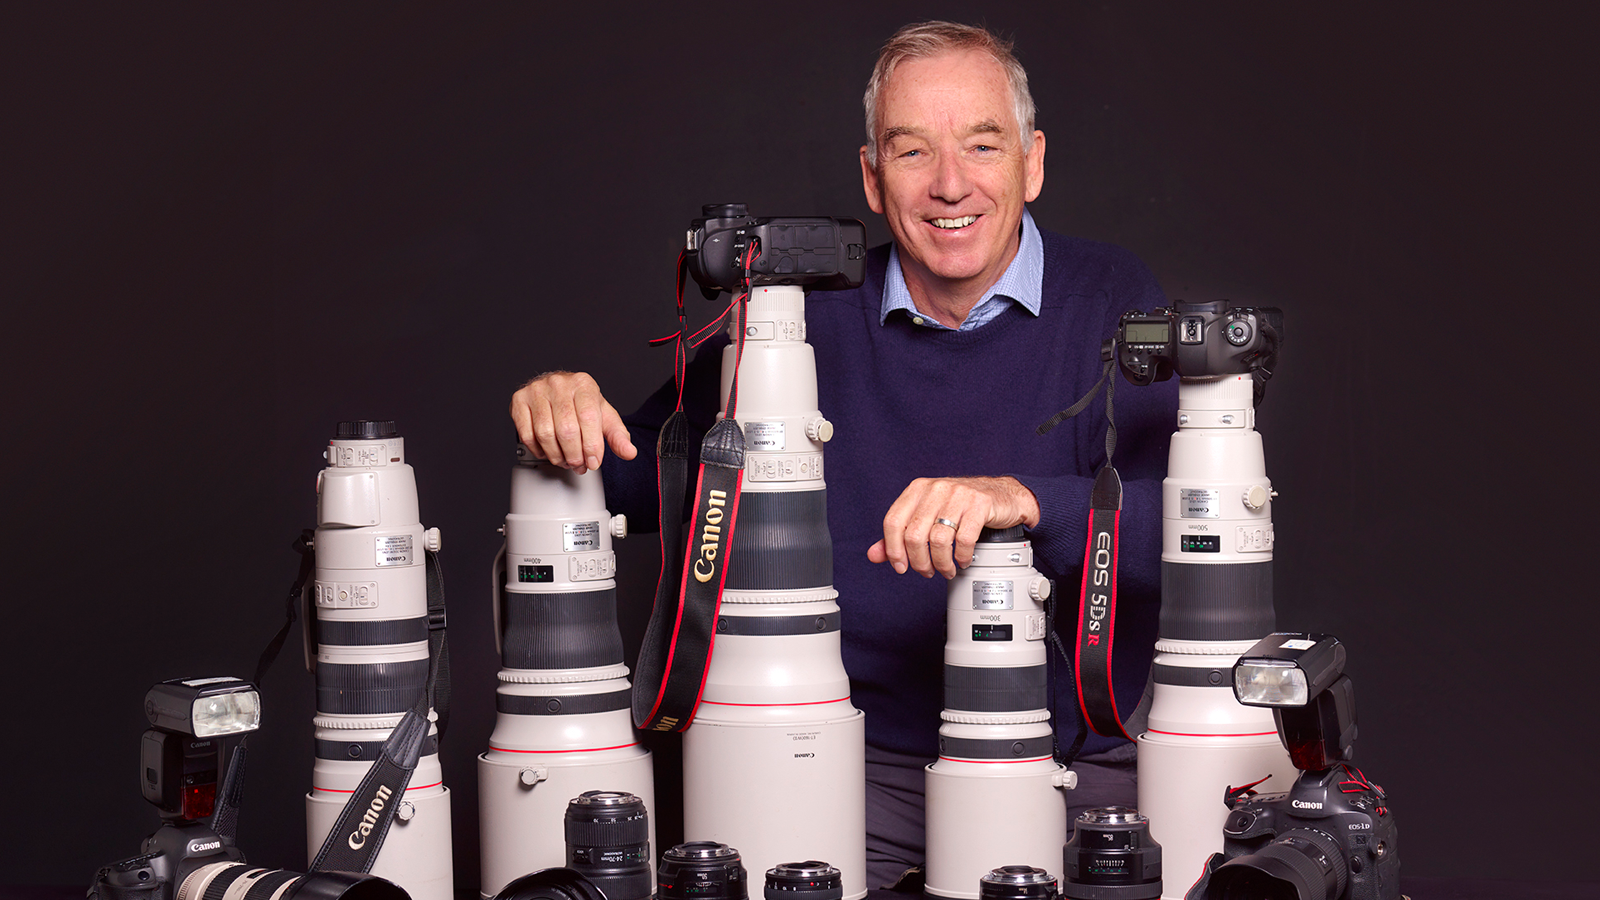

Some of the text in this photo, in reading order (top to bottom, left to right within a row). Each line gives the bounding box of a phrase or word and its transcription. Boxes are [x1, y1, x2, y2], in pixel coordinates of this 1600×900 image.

[693, 489, 727, 583] Canon
[1093, 531, 1111, 587] EOS
[190, 741, 211, 749] Canon
[348, 783, 393, 851] Canon
[1291, 799, 1323, 810] Canon
[190, 840, 221, 853] Canon
